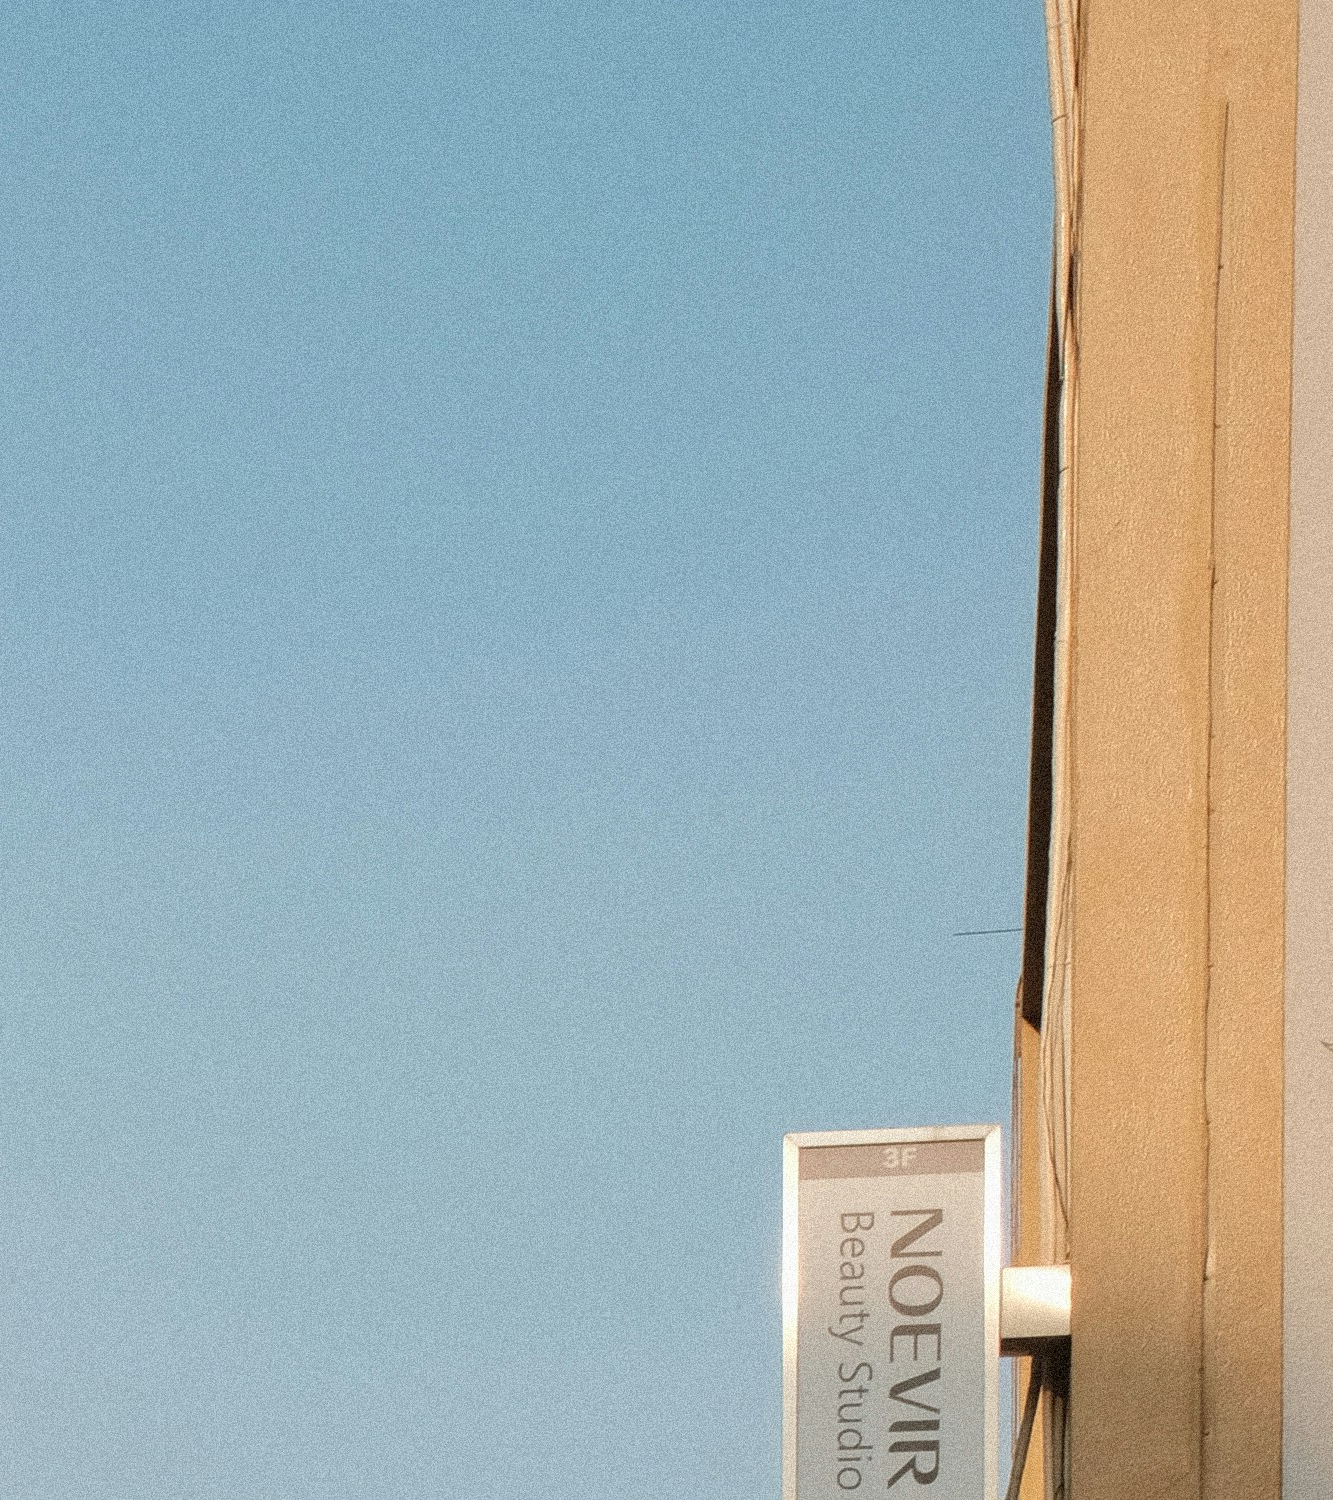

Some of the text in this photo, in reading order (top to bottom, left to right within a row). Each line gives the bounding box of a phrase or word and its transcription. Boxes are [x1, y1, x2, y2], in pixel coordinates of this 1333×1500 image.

[882, 1148, 918, 1169] 3F
[827, 1211, 875, 1491] Beauty Studio
[887, 1208, 944, 1490] NOEVIR
